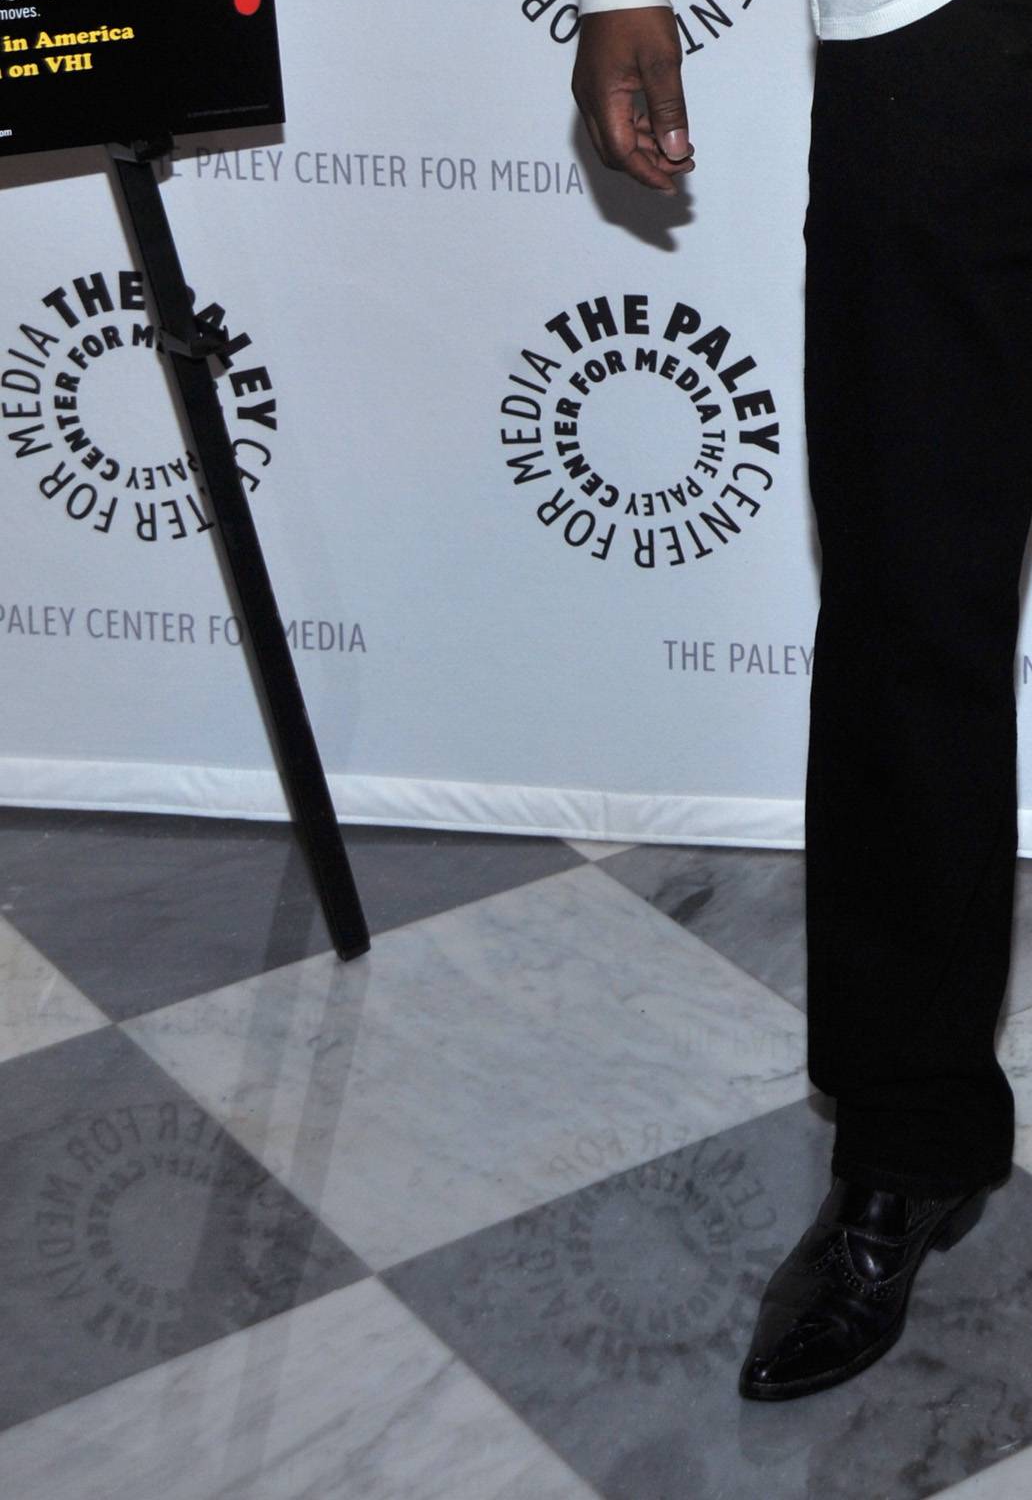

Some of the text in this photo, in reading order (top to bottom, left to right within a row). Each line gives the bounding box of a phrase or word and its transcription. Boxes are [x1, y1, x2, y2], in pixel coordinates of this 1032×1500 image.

[3, 25, 135, 52] in America
[8, 63, 39, 78] on
[196, 147, 286, 181] PALEY
[295, 152, 406, 187] CENTER
[421, 157, 477, 190] FOR
[491, 161, 584, 195] MEDIA
[41, 271, 145, 328] THE
[67, 326, 124, 370] FOR
[1, 324, 60, 458] MEDIA
[54, 372, 120, 481] CENTER
[501, 294, 779, 568] THE PALEY CENTER FOR MEDIA
[554, 348, 725, 516] THE PALEY CENTER FOR MEDIA
[39, 461, 118, 533] FOR
[135, 438, 271, 542] CETER
[86, 608, 195, 643] CENTER
[209, 615, 243, 646] FO
[663, 640, 814, 675] THE PALEY
